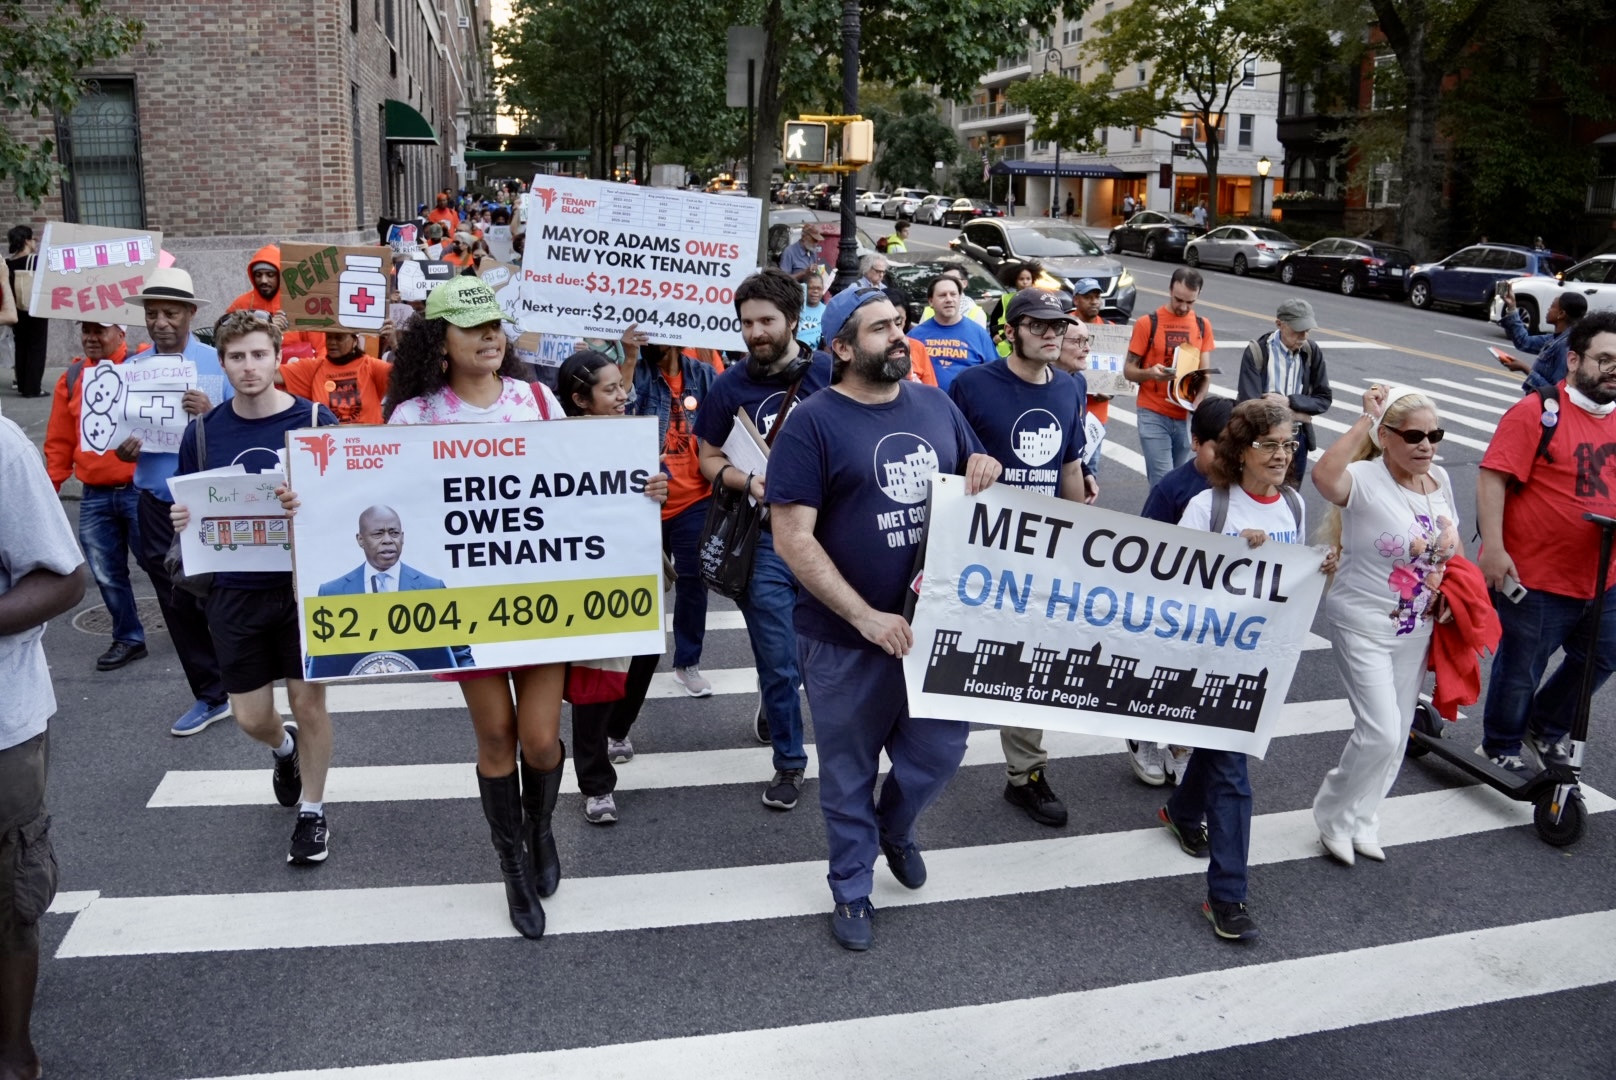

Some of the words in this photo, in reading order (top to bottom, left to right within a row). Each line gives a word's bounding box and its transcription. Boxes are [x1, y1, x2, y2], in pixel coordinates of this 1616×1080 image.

[561, 196, 597, 208] TENANT
[561, 205, 585, 215] BLOC
[542, 224, 610, 247] MAYOR
[614, 232, 681, 253] ADAMS
[685, 239, 739, 260] OWES
[547, 244, 592, 264] NEW
[594, 249, 647, 269] YORK
[650, 255, 731, 278] TENANTS
[282, 246, 339, 300] RENT
[51, 275, 144, 313] RENT
[416, 281, 427, 289] OR
[458, 286, 492, 297] FREE
[524, 269, 553, 284] Past
[555, 273, 584, 287] due:
[585, 271, 737, 305] $3,125,952,00
[305, 297, 334, 316] OR
[522, 299, 554, 314] Next
[556, 306, 592, 317] year:
[592, 302, 742, 333] $2,004,480,000
[605, 327, 625, 335] DELIVER
[542, 340, 556, 360] MY
[556, 341, 576, 361] REN
[925, 338, 961, 347] TENANTS
[926, 346, 968, 359] ZOHRAN
[125, 366, 193, 383] MEDICINE
[157, 429, 184, 447] REN
[432, 437, 526, 460] INVOICE
[343, 443, 401, 457] TENANT
[346, 457, 384, 470] BLOC
[1004, 467, 1027, 482] MET
[1028, 468, 1059, 483] COUNCI
[208, 486, 240, 504] Rent
[256, 483, 276, 491] Sub
[443, 474, 522, 503] ERIC
[529, 469, 649, 499] ADAMS
[444, 506, 545, 536] OWES
[876, 510, 906, 531] MET
[887, 530, 906, 548] ON
[444, 535, 606, 569] TENANTS
[968, 502, 1074, 560] MET
[1082, 527, 1289, 603] COUNCIL
[311, 587, 653, 643] $2,004,480,000
[957, 563, 1034, 615] ON
[1046, 577, 1268, 651] HOUSING
[963, 678, 1023, 701] Housing
[1026, 685, 1049, 701] for
[1051, 688, 1100, 709] People
[1127, 699, 1155, 715] Not
[1157, 703, 1197, 720] Profit
